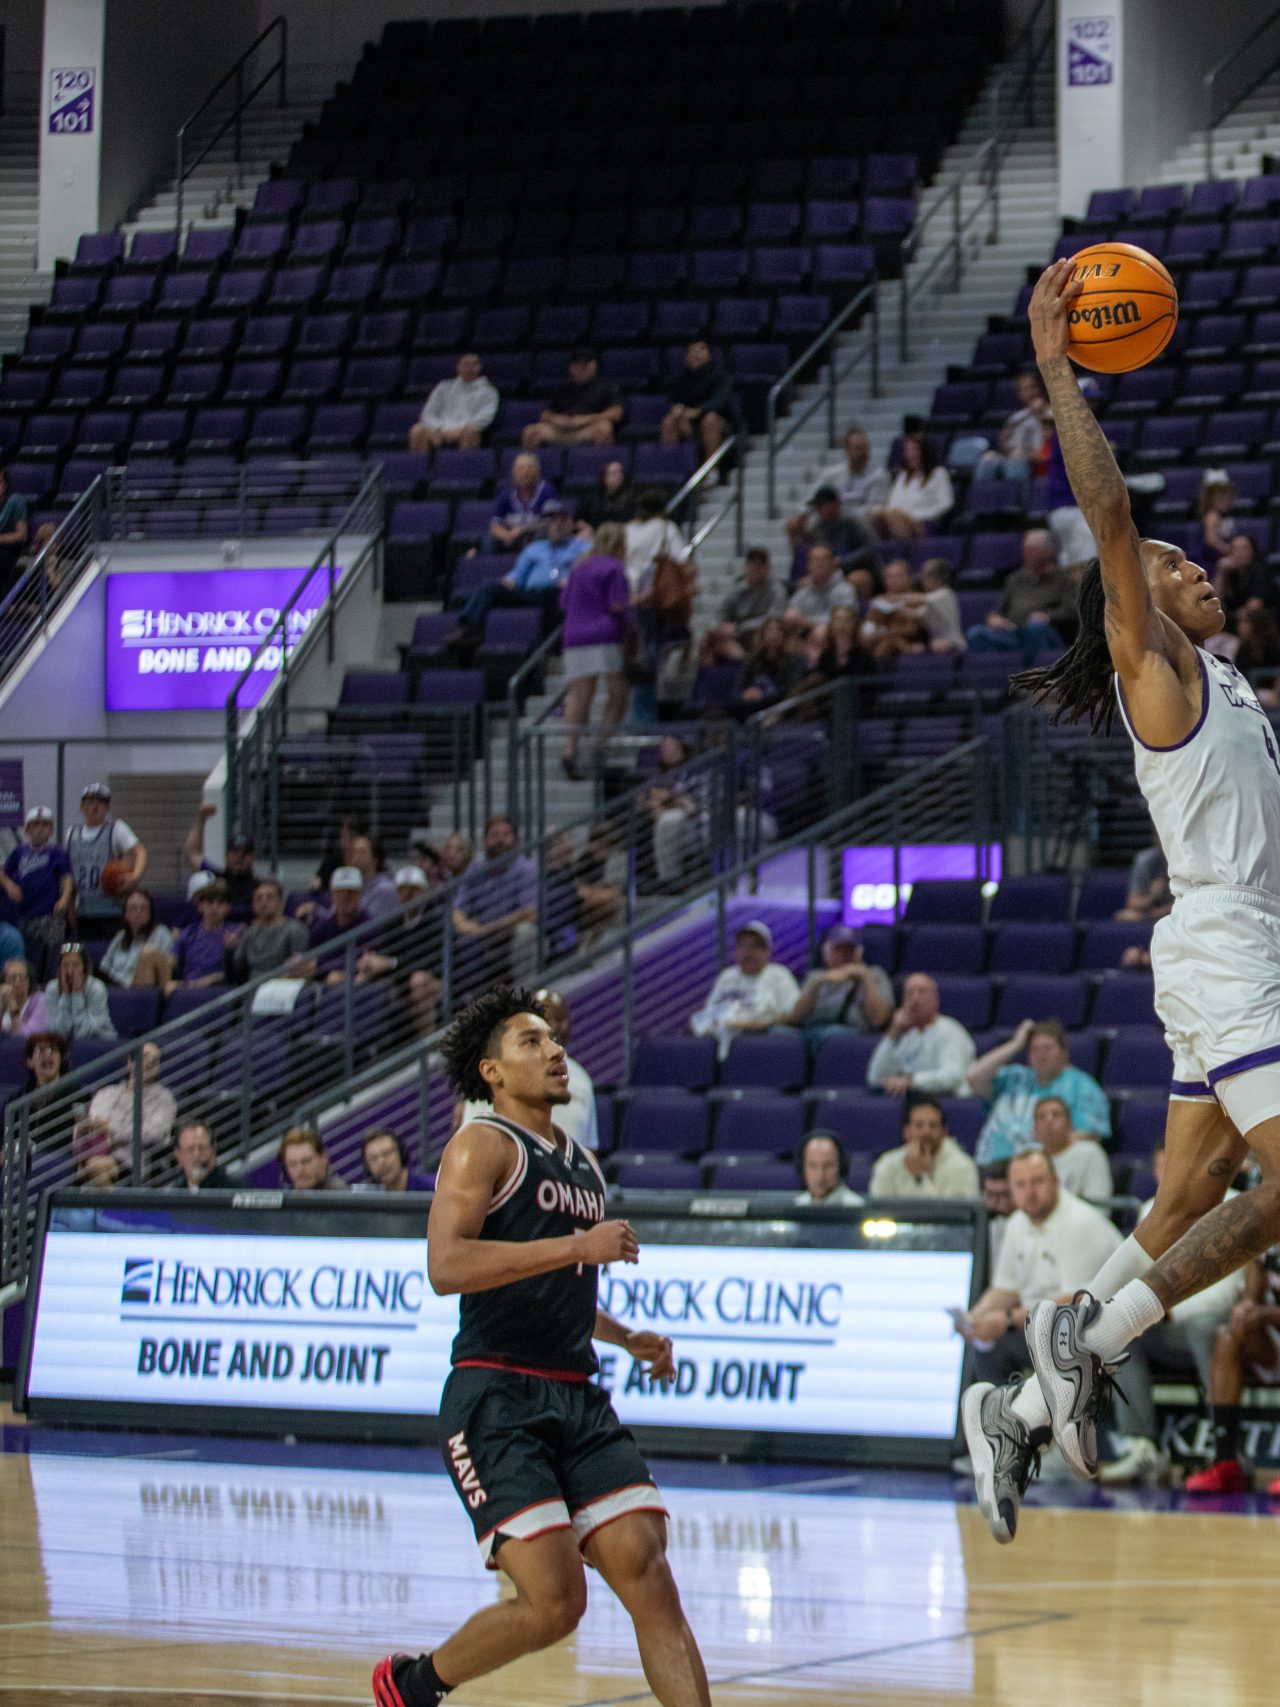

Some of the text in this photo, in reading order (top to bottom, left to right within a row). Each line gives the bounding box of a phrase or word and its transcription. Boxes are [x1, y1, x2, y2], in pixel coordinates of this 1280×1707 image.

[54, 70, 91, 89] 120
[52, 110, 90, 132] 101
[1067, 300, 1142, 330] Wilso
[138, 647, 200, 674] BONE
[202, 646, 252, 672] AND
[537, 1179, 605, 1222] OMAHA
[153, 1259, 425, 1314] HENDRICK CLINIC
[598, 1276, 843, 1326] DRICK CLINIC
[136, 1335, 391, 1385] BONE AND JOINT
[705, 1359, 806, 1404] JOINT
[448, 1430, 487, 1509] MAVS
